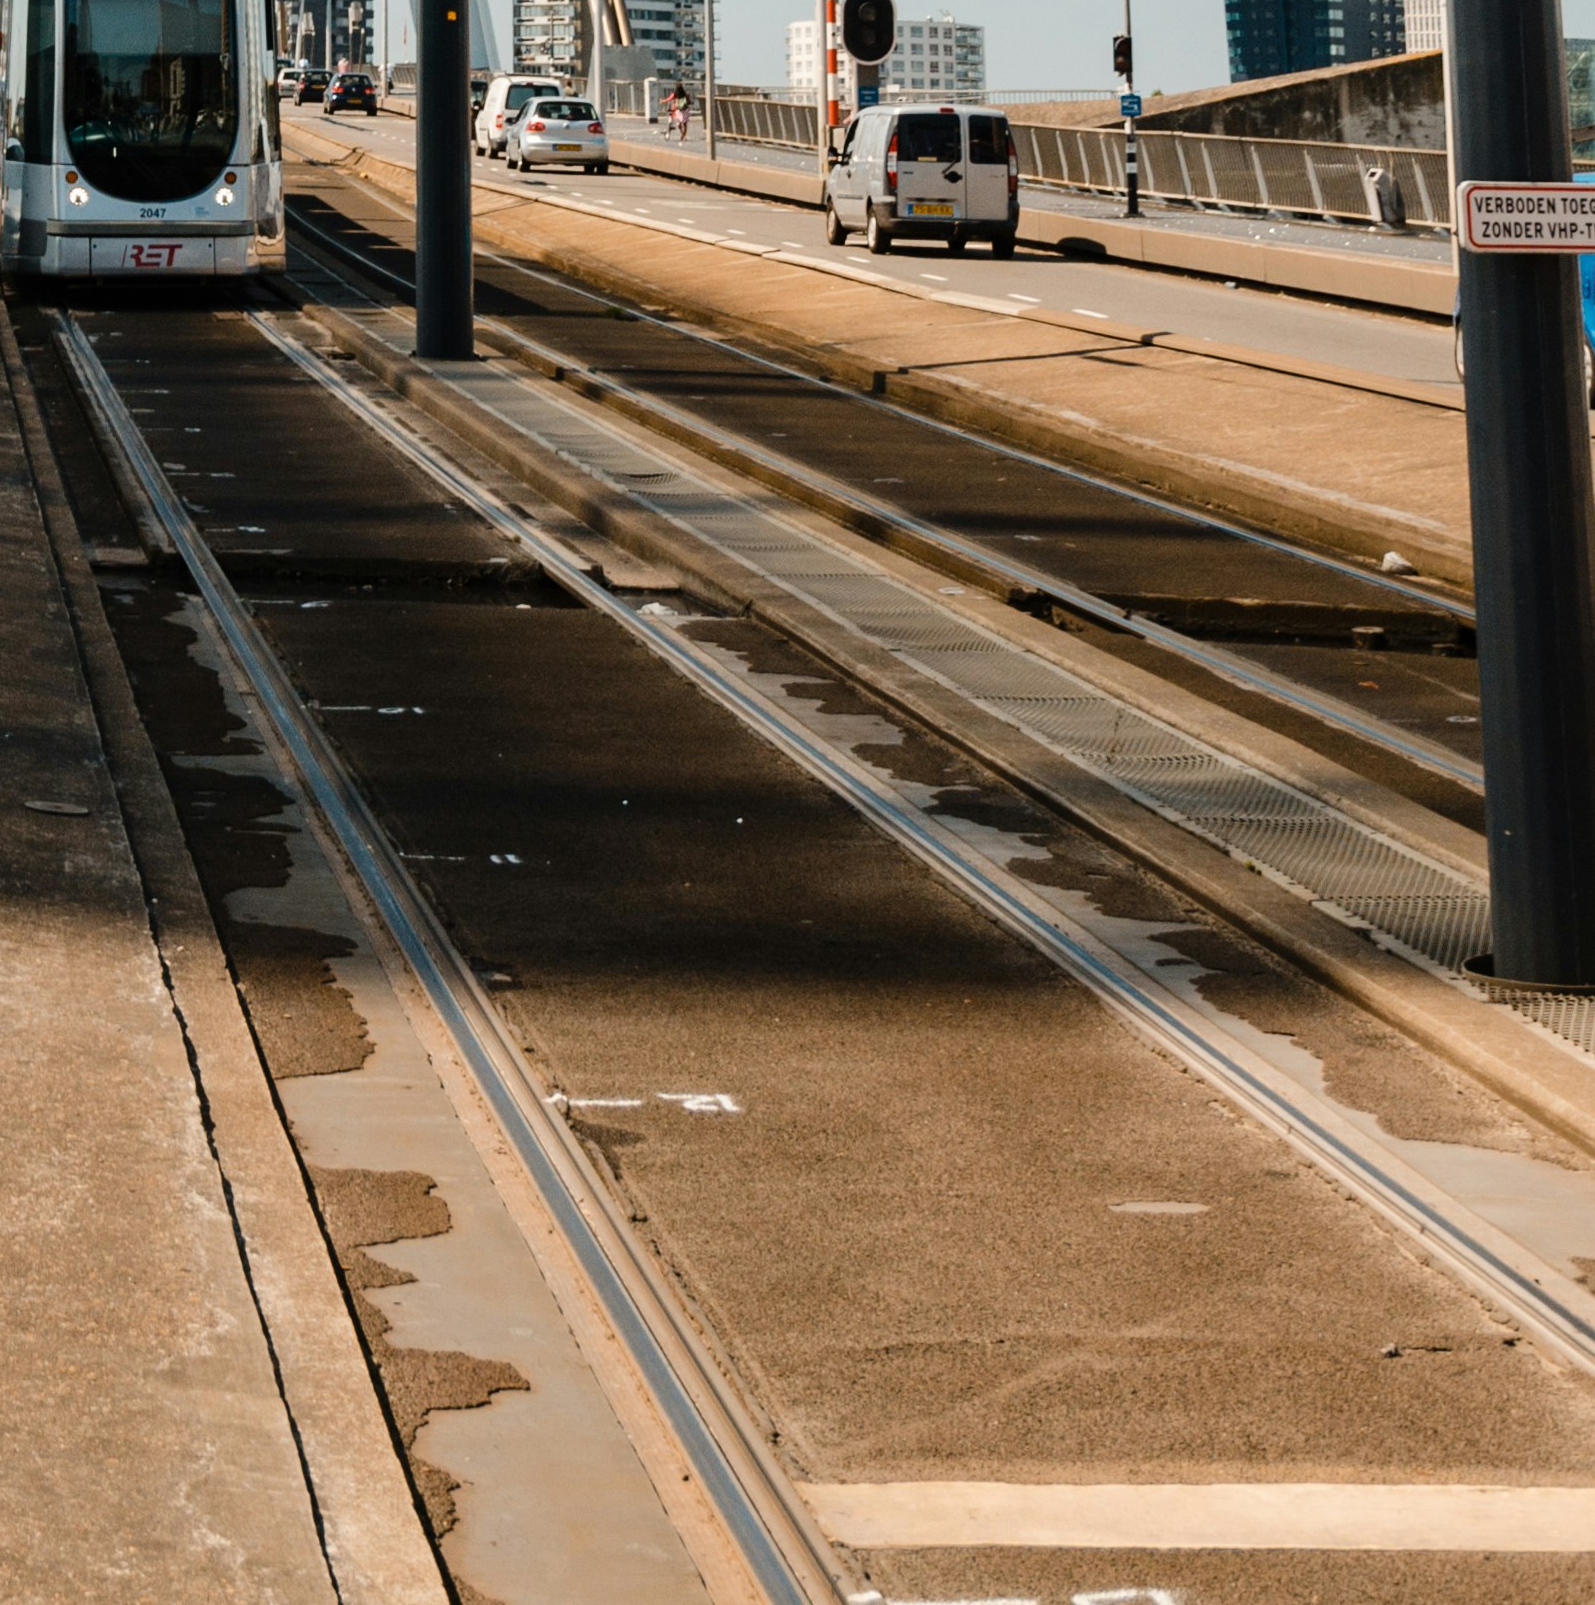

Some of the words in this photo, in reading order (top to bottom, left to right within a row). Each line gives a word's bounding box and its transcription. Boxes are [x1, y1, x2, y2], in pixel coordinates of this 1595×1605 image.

[140, 208, 166, 218] 2047
[1473, 196, 1556, 214] VERBODEN
[1482, 221, 1543, 238] ZONDER
[1547, 222, 1595, 239] VHP-T
[130, 243, 183, 267] RET
